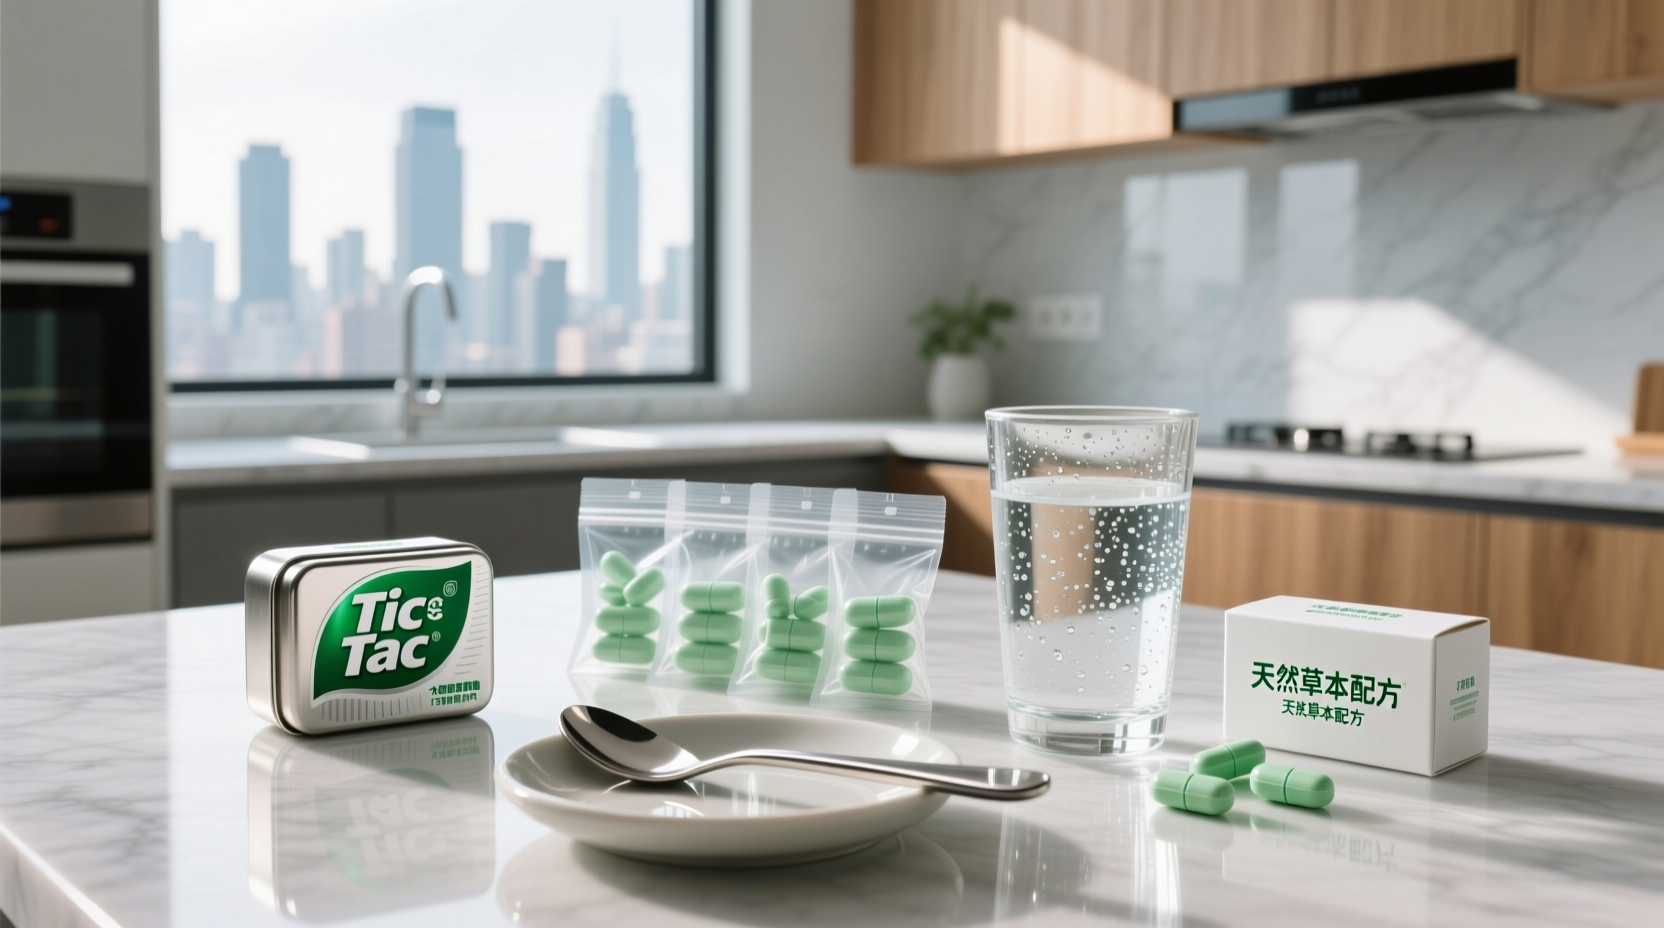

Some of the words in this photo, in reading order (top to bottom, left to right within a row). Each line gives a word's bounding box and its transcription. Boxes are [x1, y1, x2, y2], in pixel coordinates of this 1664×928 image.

[352, 587, 427, 634] Tic
[341, 633, 430, 677] Tac
[1251, 661, 1402, 709] 天然草本配方
